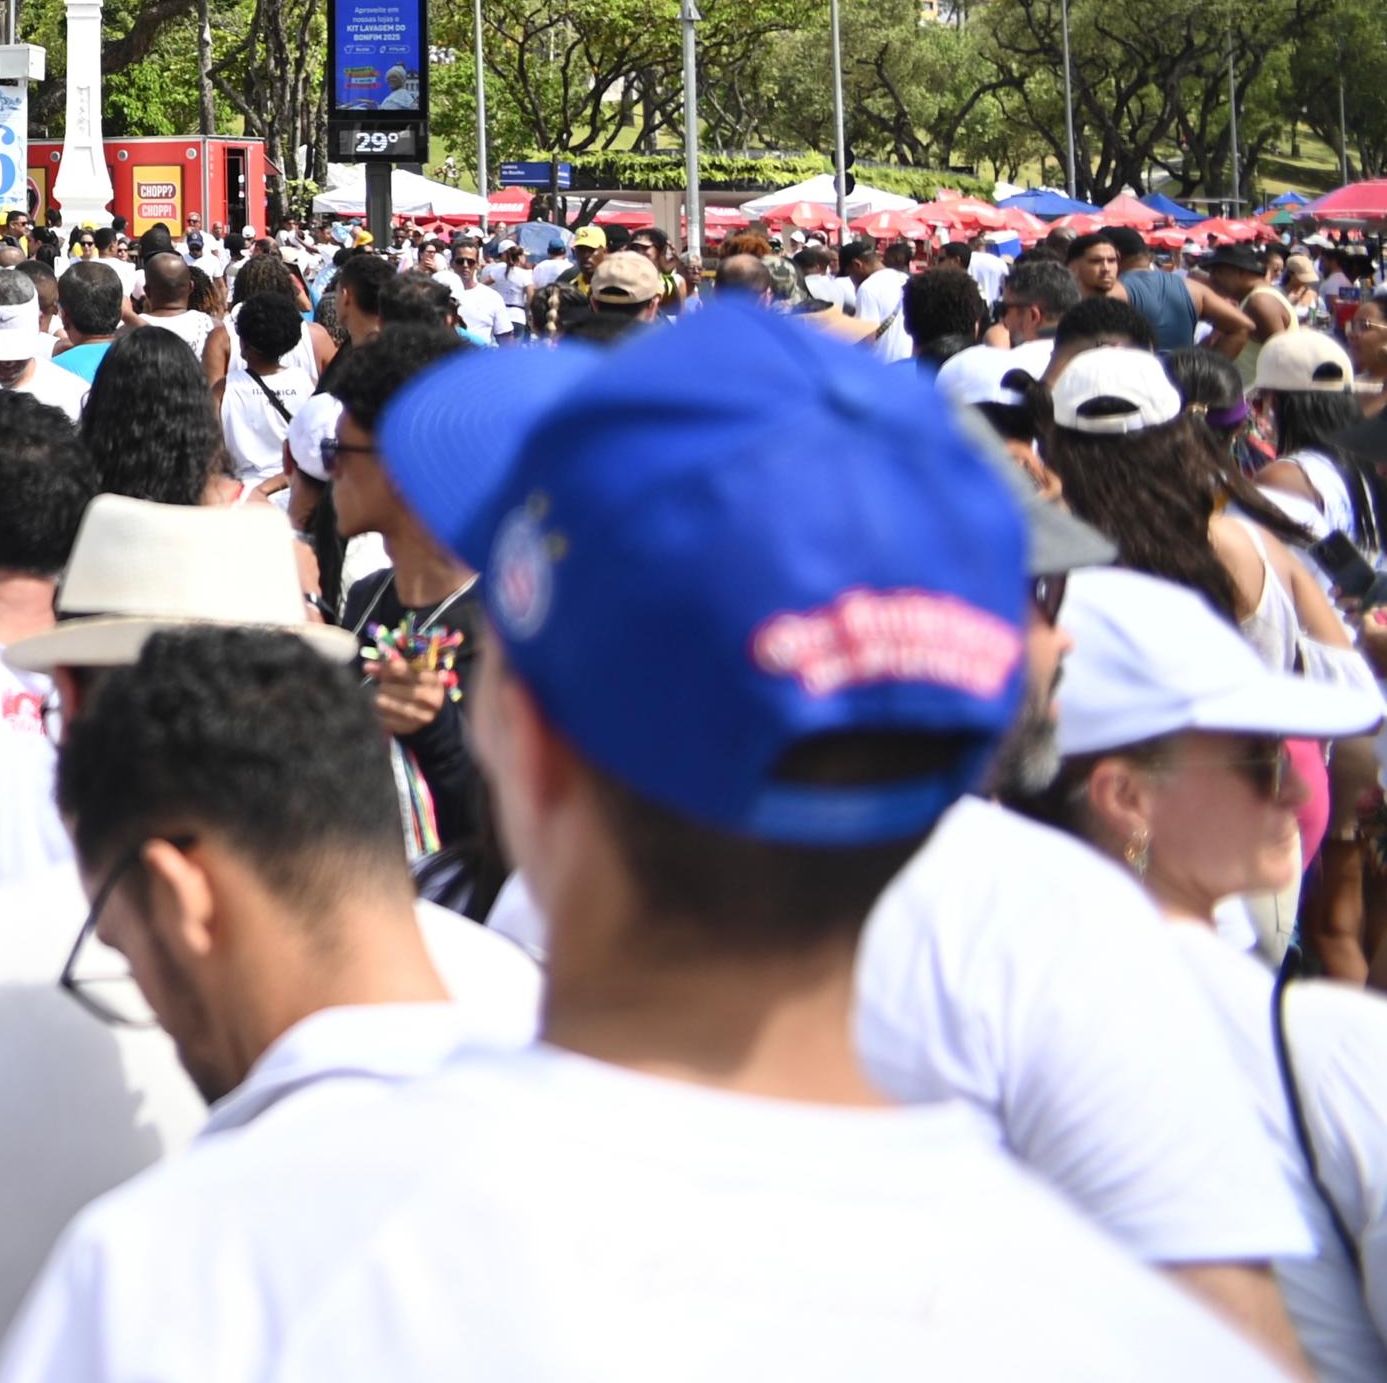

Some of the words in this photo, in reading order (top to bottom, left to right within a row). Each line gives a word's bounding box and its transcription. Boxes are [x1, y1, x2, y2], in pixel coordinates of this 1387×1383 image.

[347, 24, 359, 32] KIT
[359, 24, 394, 32] LAVAGEM
[353, 33, 382, 41] BONFIM
[355, 132, 399, 152] 29°
[140, 185, 173, 197] CHOPP?
[141, 204, 172, 217] CHOPP!
